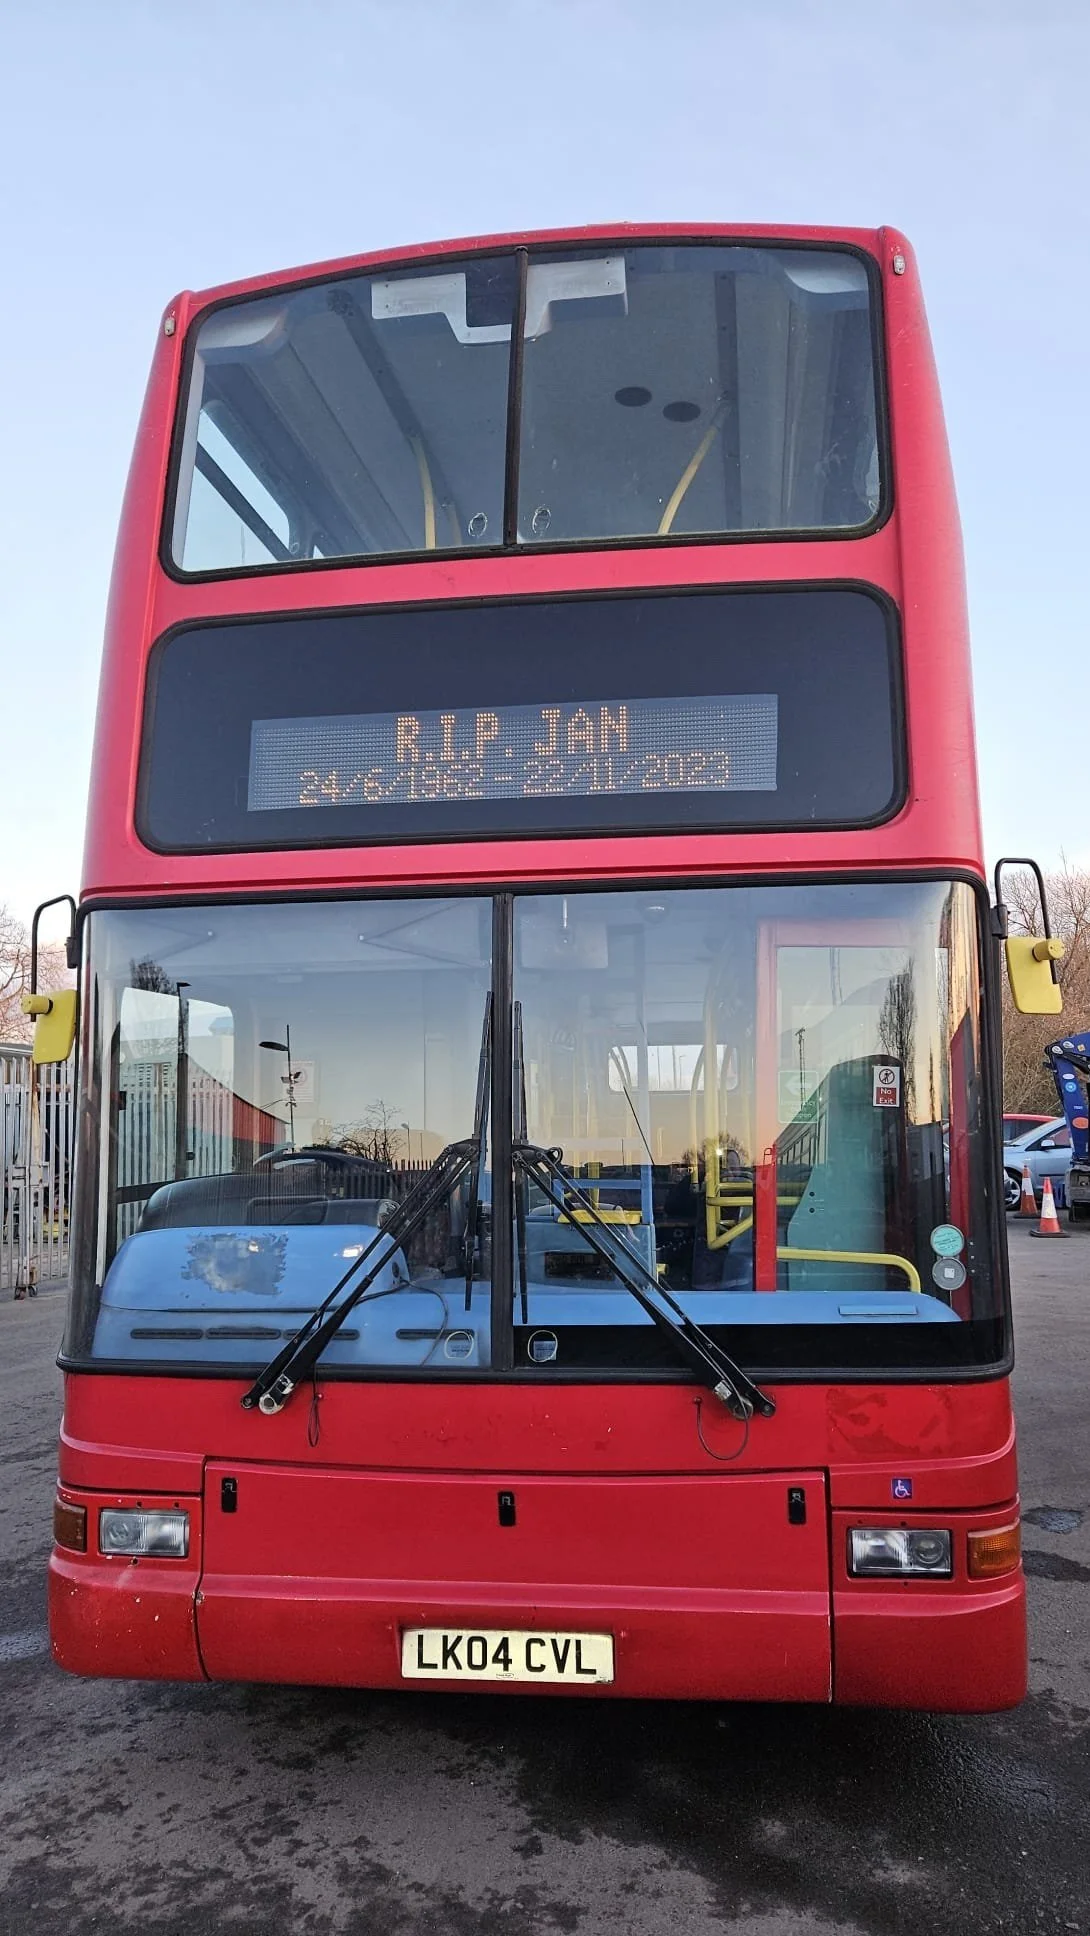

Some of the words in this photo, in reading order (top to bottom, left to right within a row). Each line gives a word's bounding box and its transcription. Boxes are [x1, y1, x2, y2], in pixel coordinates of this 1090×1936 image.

[397, 712, 513, 762] R.I.P.
[535, 706, 627, 755] JAN
[300, 765, 483, 804] 24/6/1962
[524, 751, 729, 793] 22/11/2023
[417, 1634, 513, 1672] LK04
[525, 1637, 597, 1675] CVL
